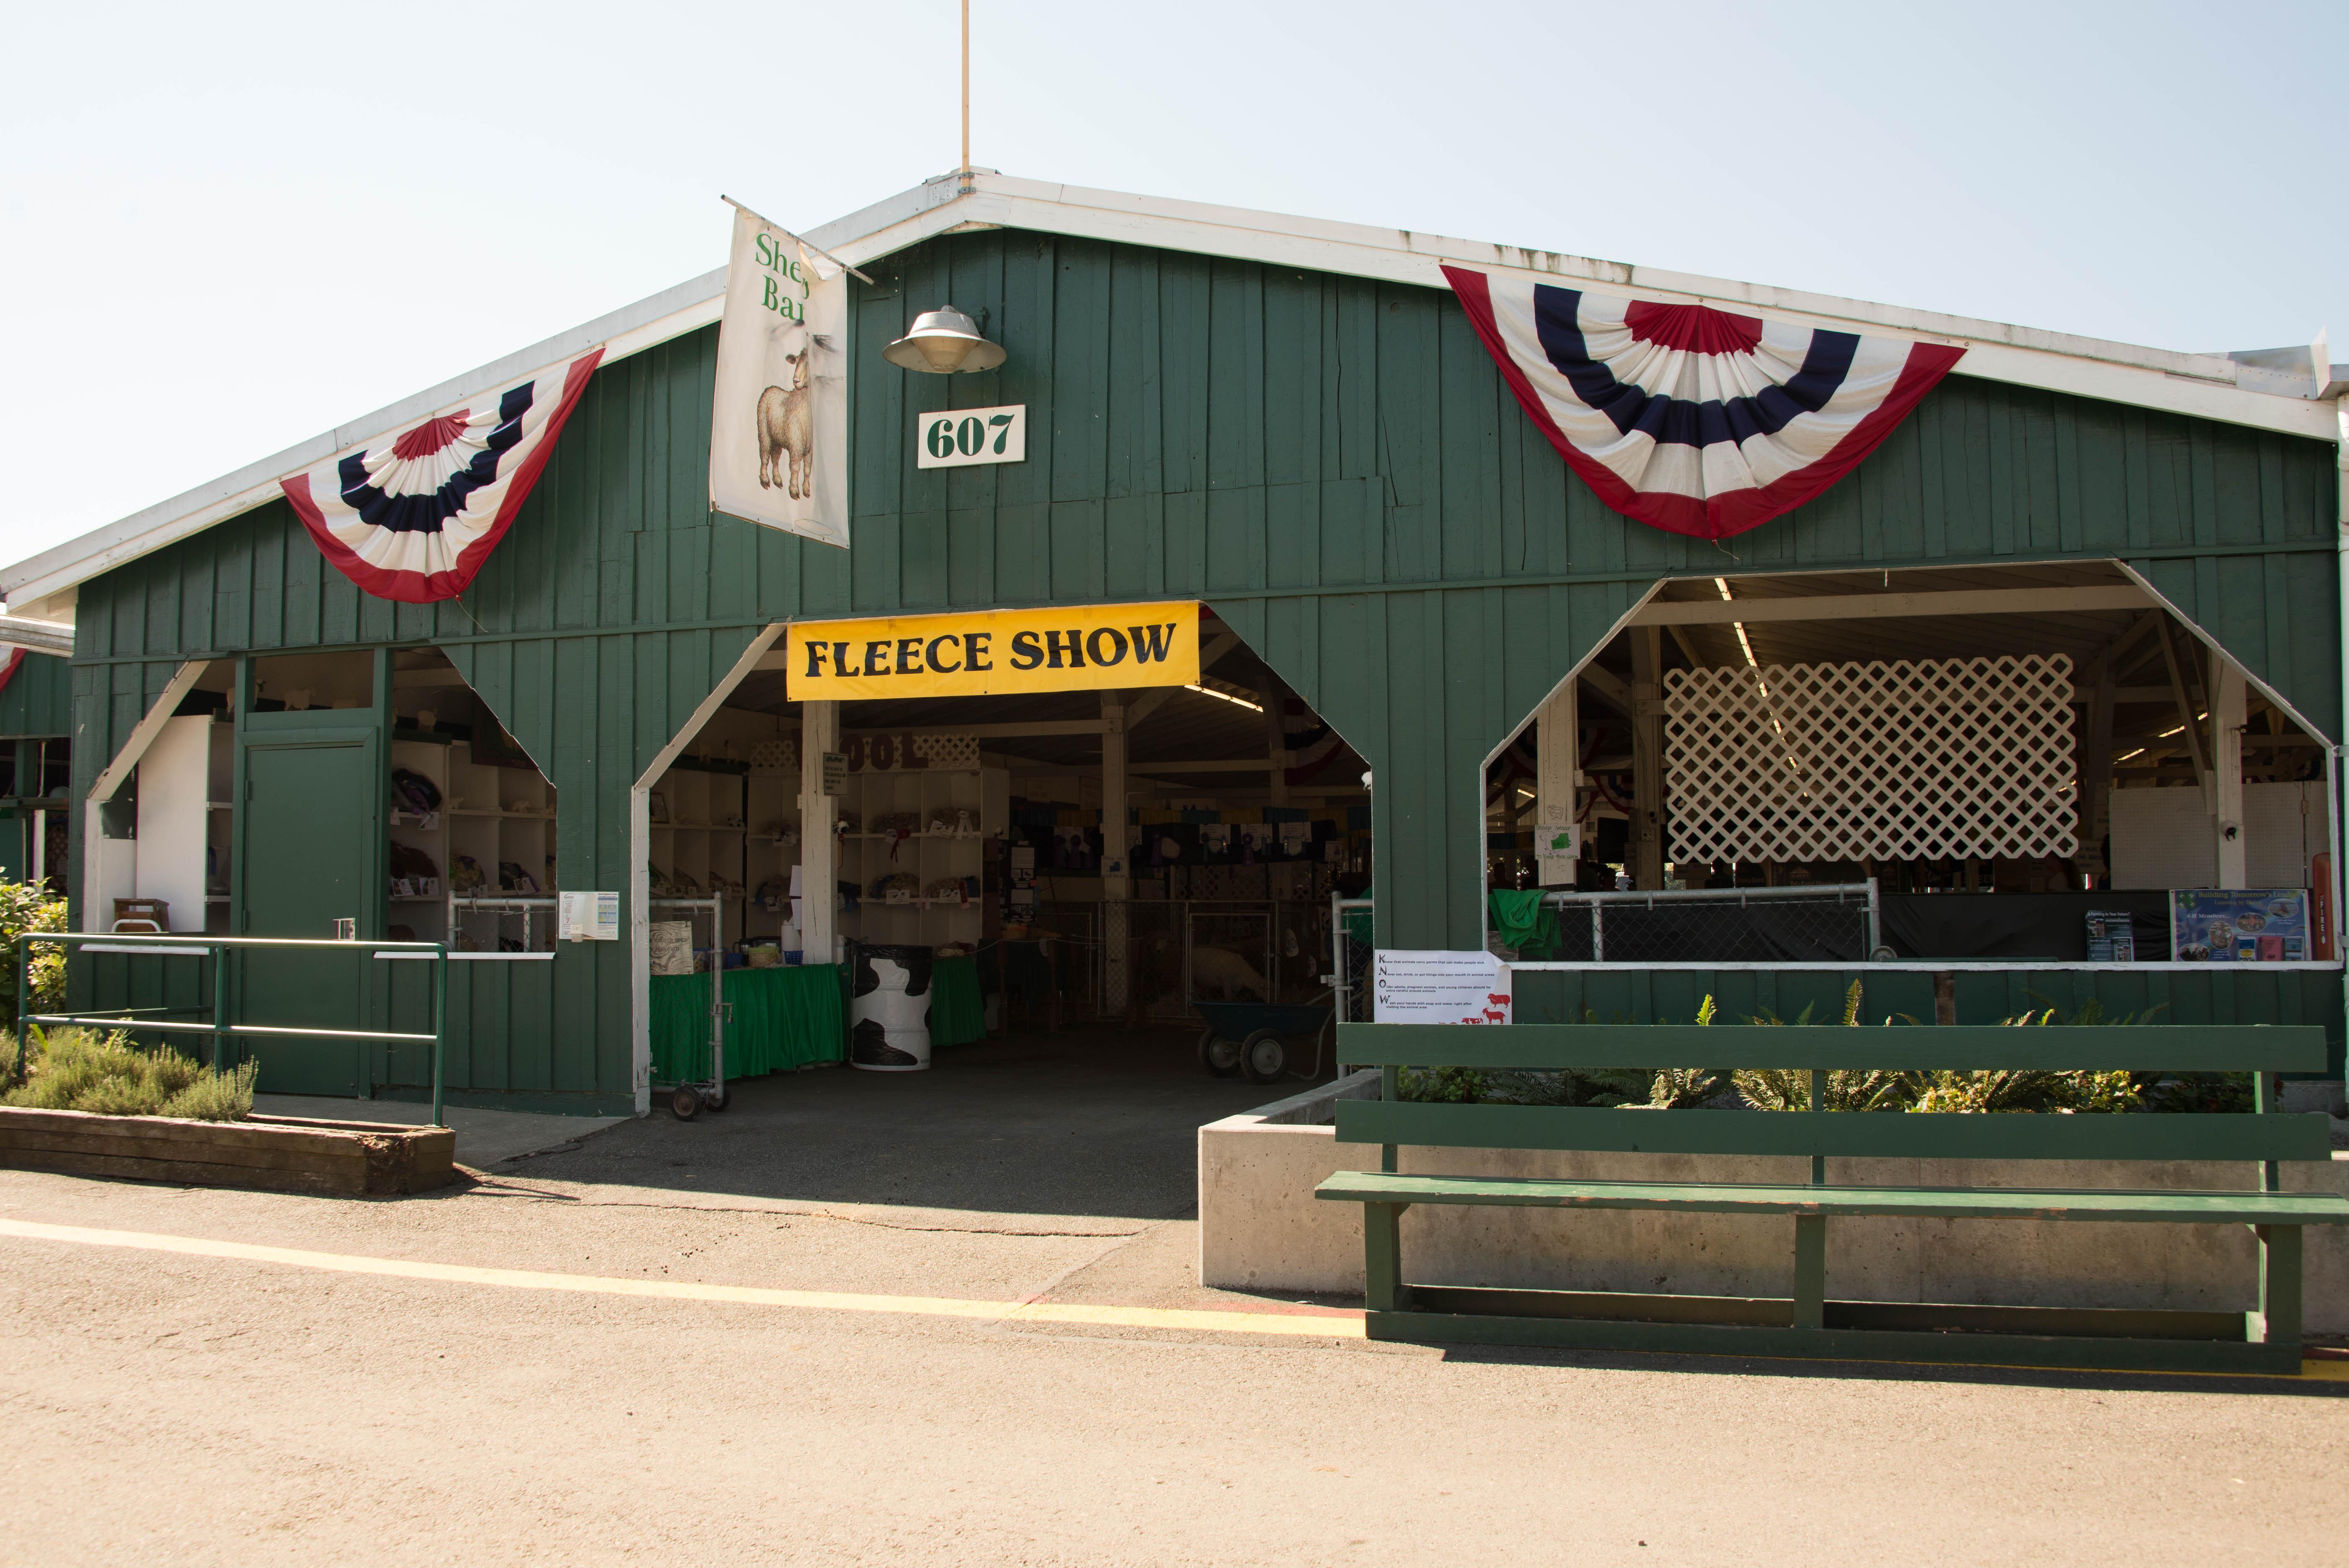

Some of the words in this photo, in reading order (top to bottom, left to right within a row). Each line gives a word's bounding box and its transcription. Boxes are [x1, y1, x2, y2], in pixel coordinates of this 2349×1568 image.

[927, 414, 1014, 458] 607
[805, 632, 993, 677] FLEECE
[1010, 623, 1177, 670] SHOW
[791, 729, 928, 772] OOL
